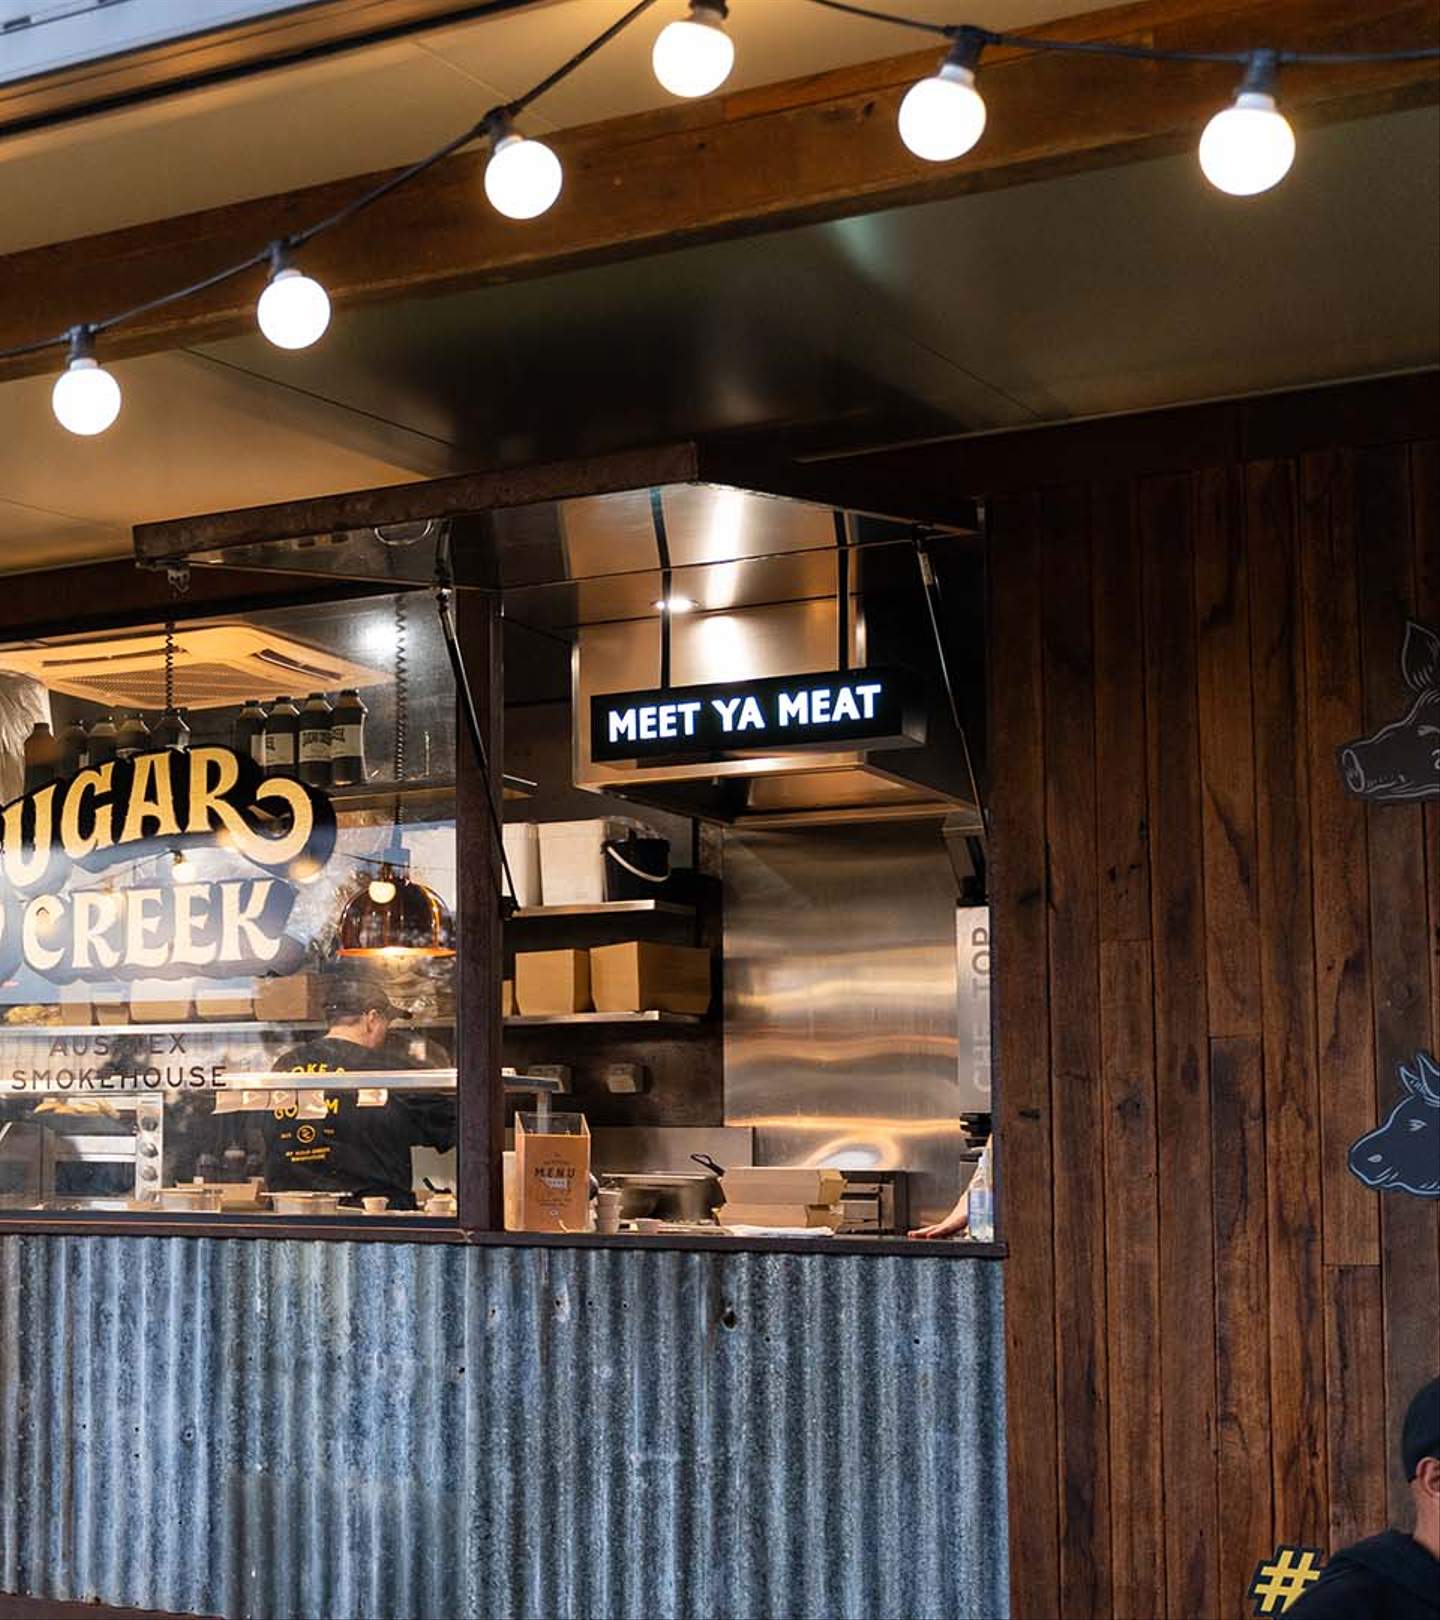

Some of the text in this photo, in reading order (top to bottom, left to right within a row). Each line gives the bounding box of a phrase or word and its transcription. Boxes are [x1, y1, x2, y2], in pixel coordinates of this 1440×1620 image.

[608, 684, 881, 743] MEET YA MEAT
[22, 879, 282, 970] CREEK
[11, 1066, 227, 1090] SMOKEHOUSE
